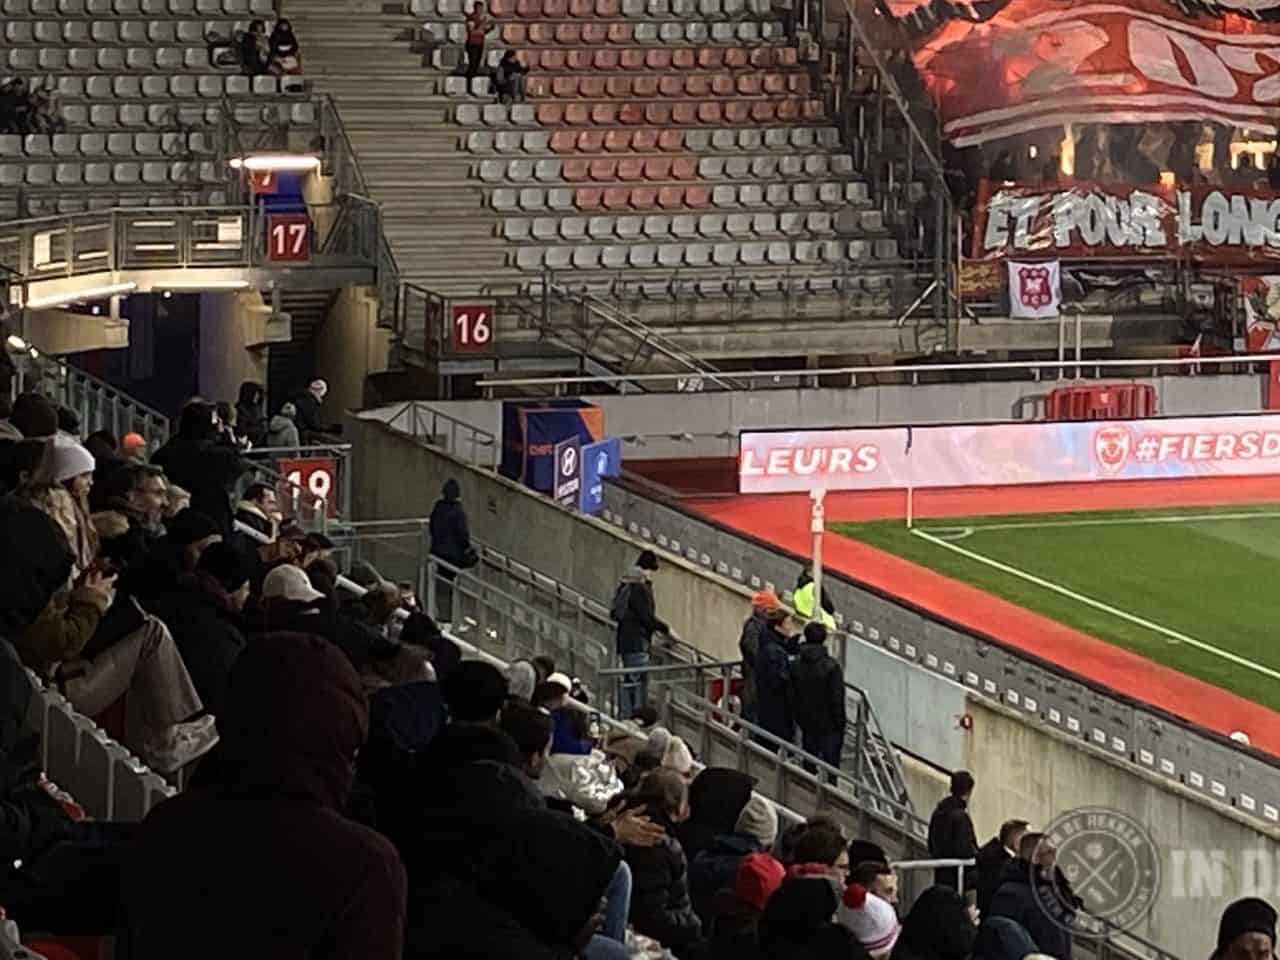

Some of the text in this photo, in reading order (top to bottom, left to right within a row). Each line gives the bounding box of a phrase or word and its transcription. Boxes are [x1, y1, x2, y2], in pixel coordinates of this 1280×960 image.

[984, 192, 1040, 250] ET
[1053, 189, 1167, 247] POUR
[273, 224, 306, 254] 17
[457, 313, 490, 344] 16
[741, 445, 877, 475] LEURS
[288, 470, 330, 510] 19
